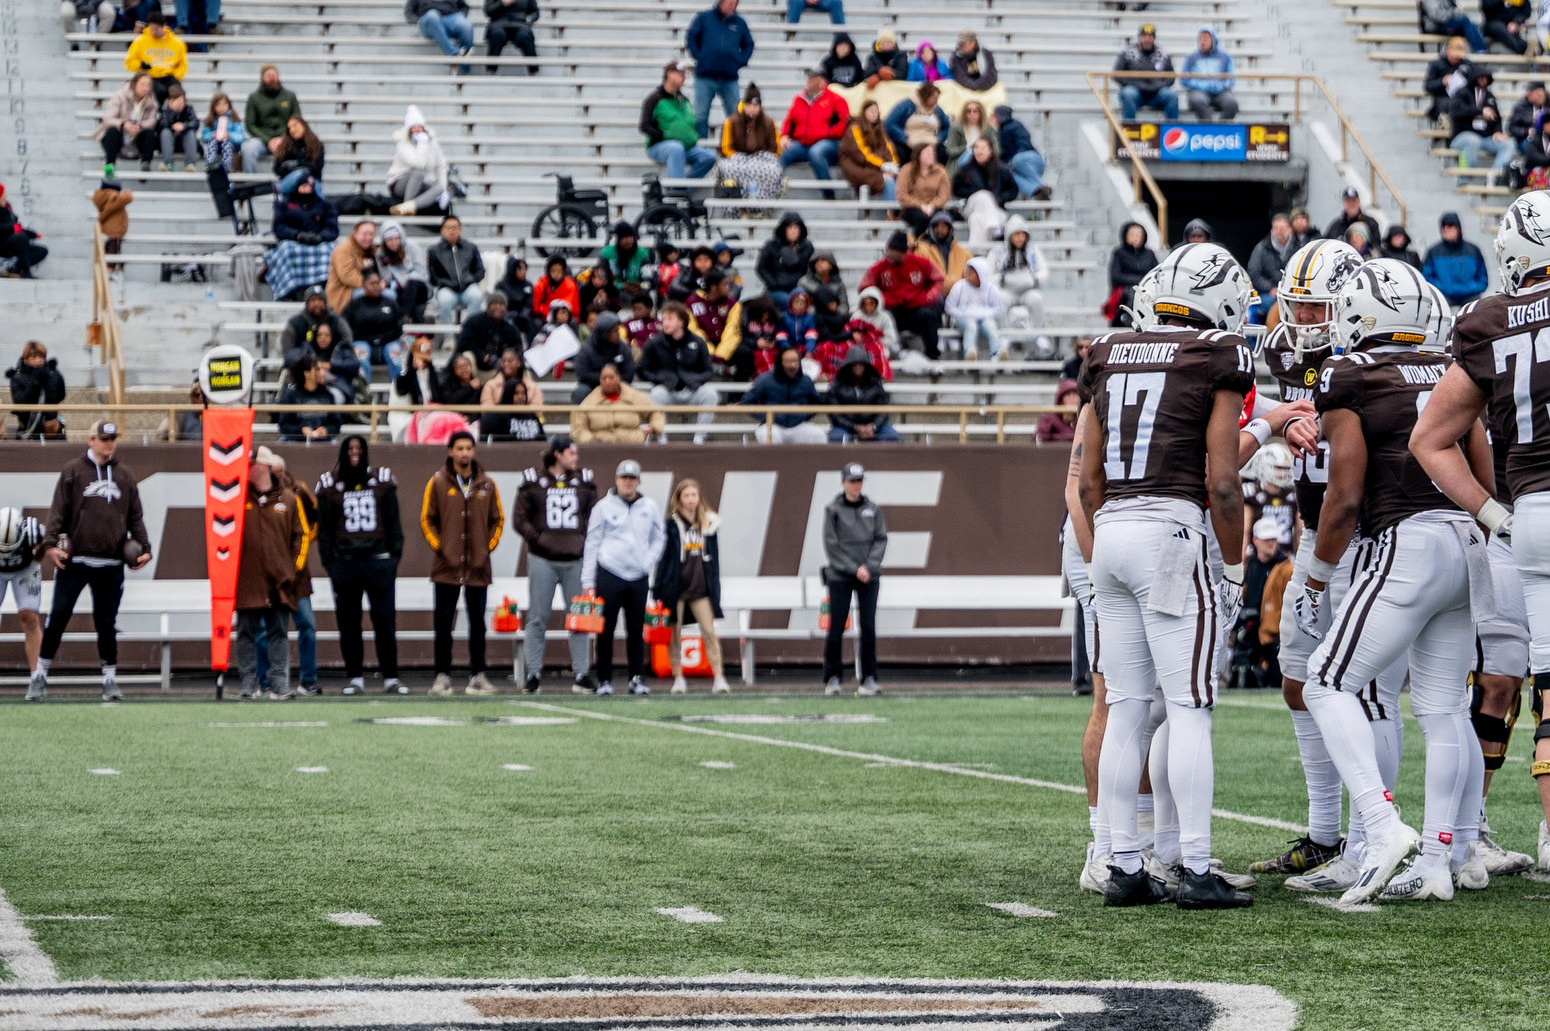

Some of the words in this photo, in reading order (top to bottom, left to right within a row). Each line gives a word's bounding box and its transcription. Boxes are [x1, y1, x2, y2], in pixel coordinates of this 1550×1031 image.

[1141, 124, 1157, 142] P
[1190, 133, 1241, 152] pepsi
[1250, 126, 1266, 145] R
[1154, 303, 1190, 316] BRONCOS
[1507, 297, 1550, 329] KUSHI
[1392, 332, 1425, 344] BRONCOS
[1107, 343, 1180, 365] DIEUDONNE
[1236, 344, 1253, 373] 17
[210, 360, 240, 373] MORGAN
[211, 374, 240, 387] MORGAN
[1320, 367, 1334, 393] 9
[1284, 386, 1315, 402] BRON
[1104, 372, 1166, 481] 17
[546, 494, 580, 529] 62
[680, 640, 701, 667] G
